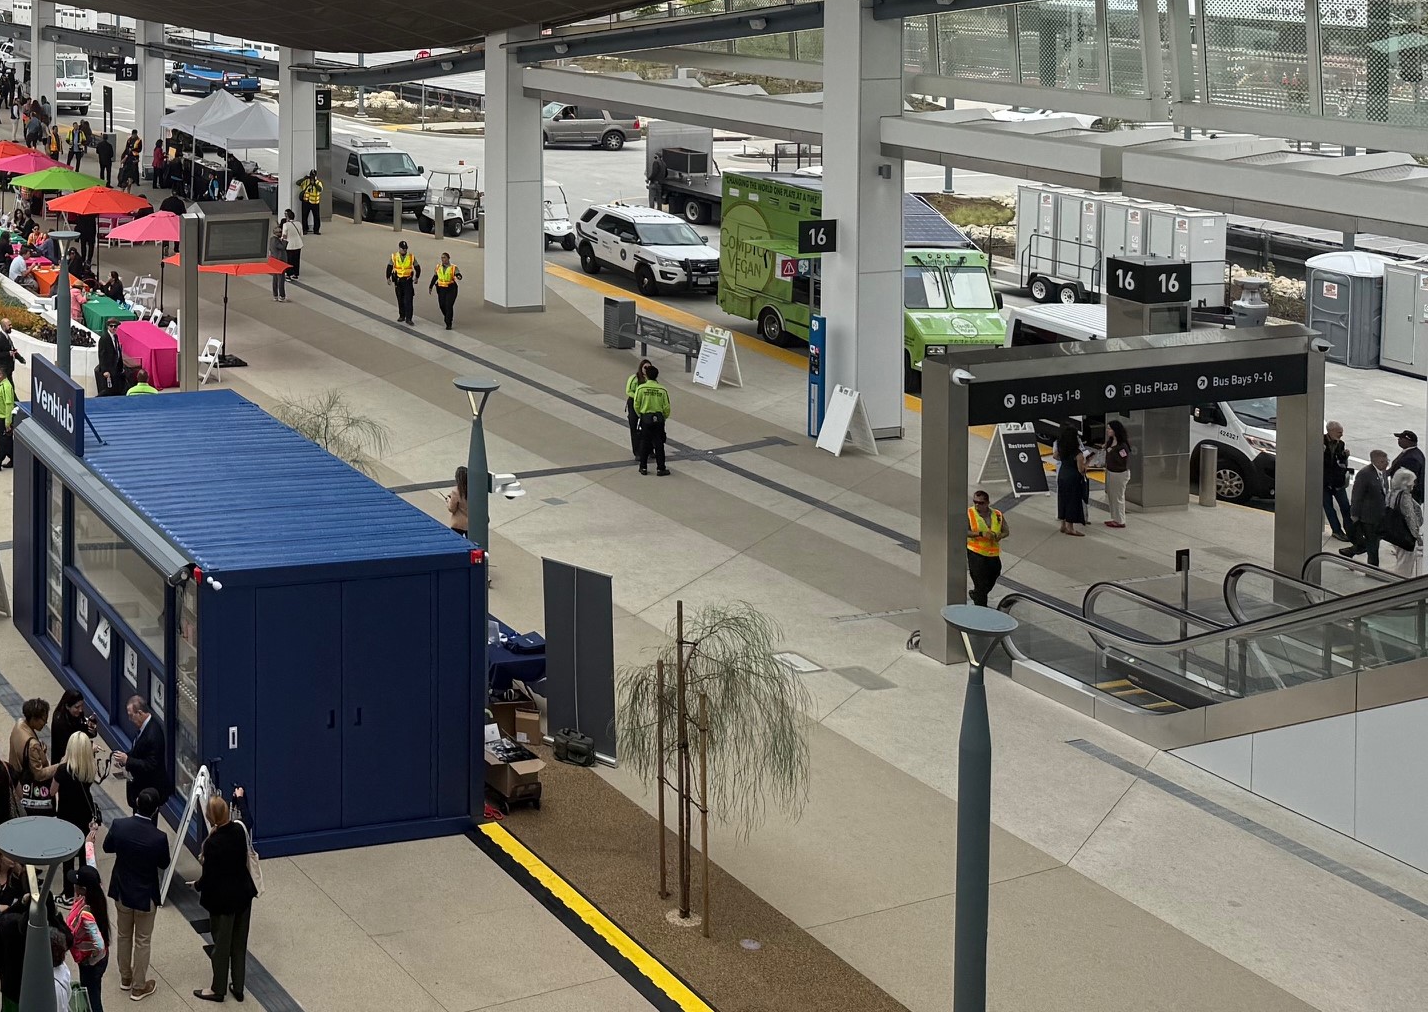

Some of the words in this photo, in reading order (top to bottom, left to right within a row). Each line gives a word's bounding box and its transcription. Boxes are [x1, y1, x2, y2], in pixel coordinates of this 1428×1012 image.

[121, 68, 133, 78] 15
[317, 94, 324, 106] 5
[808, 228, 827, 246] 16
[1116, 269, 1135, 291] 16
[1158, 272, 1179, 293] 16
[1212, 375, 1231, 386] Bus
[1231, 373, 1252, 386] Bays
[1253, 372, 1273, 383] 9-16
[1134, 383, 1152, 394] Bus
[1153, 381, 1179, 393] Plaza
[34, 376, 74, 434] VenHub
[1021, 393, 1039, 405] Bus
[1040, 391, 1063, 404] Bays
[1065, 389, 1081, 401] 1-8
